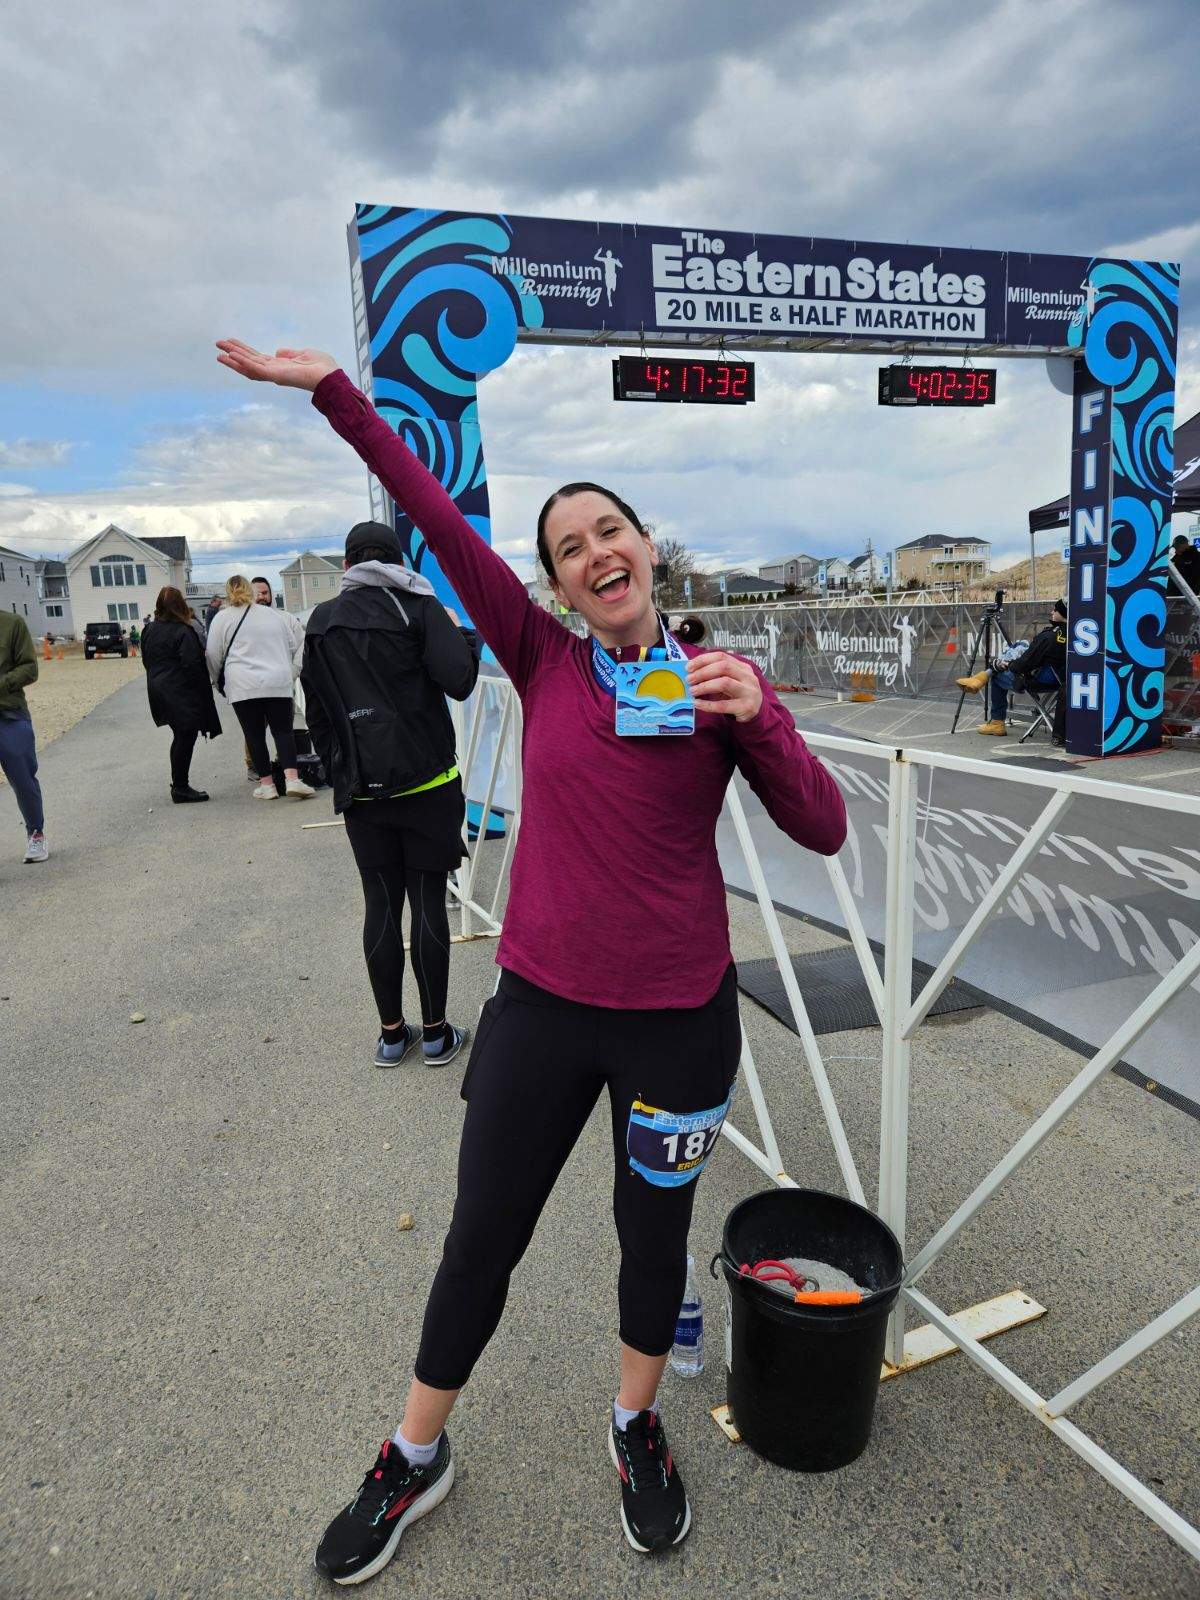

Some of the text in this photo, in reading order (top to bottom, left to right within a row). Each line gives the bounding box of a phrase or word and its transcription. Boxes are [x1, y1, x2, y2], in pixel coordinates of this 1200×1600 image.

[681, 231, 726, 255] The
[491, 255, 602, 281] Millennium
[652, 243, 986, 306] Eastern States
[520, 278, 602, 307] Running
[1007, 286, 1085, 306] Millennium
[667, 299, 975, 332] 20 MILE & HALF MARATHON
[1025, 305, 1084, 327] Running
[1069, 391, 1106, 711] FINISH
[714, 630, 768, 649] Millennium
[816, 630, 898, 653] Millennium
[833, 654, 898, 686] Running
